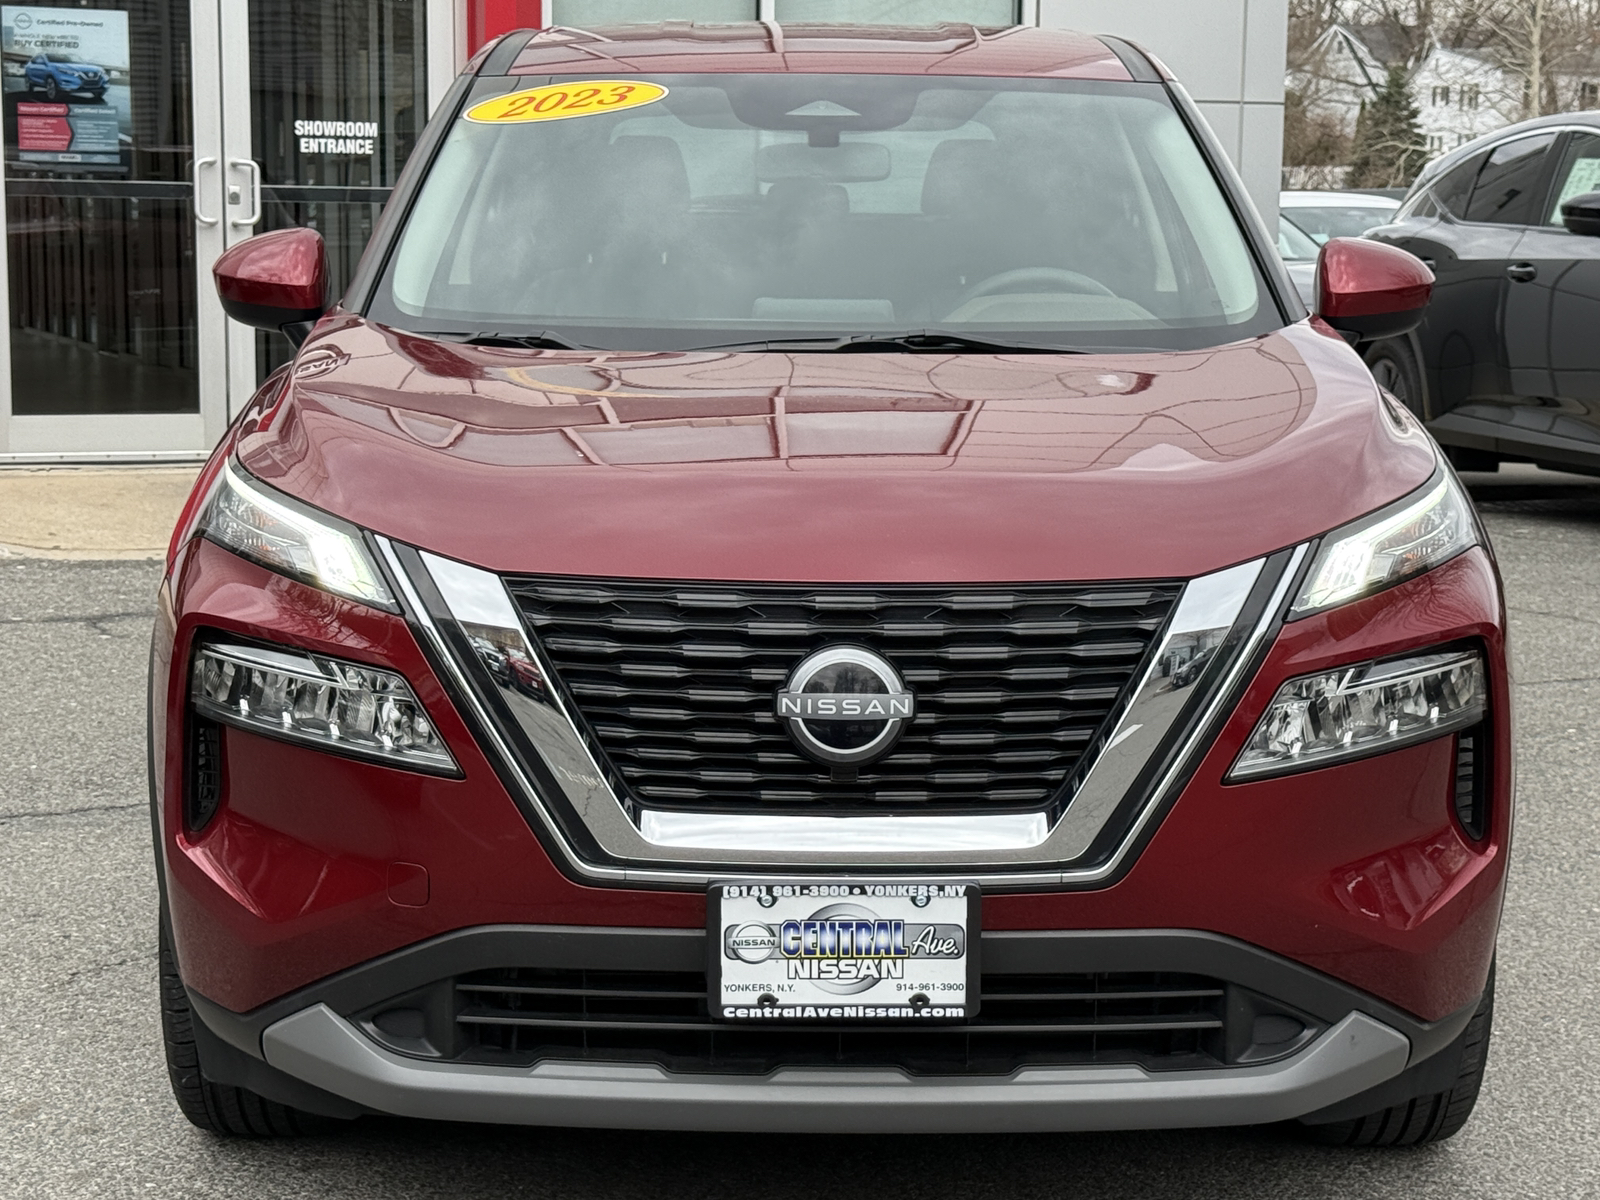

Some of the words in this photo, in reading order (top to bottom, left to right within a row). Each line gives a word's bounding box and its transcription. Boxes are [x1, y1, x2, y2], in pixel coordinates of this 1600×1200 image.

[34, 40, 80, 48] CERTIFIED
[497, 85, 636, 119] 2023
[294, 119, 378, 137] SHOWROOM
[299, 138, 374, 154] ENTRANCE
[781, 697, 909, 715] NISSAN
[780, 920, 910, 958] CENTRAL
[911, 925, 960, 955] Ave.
[787, 958, 904, 979] NISSAN
[724, 984, 775, 993] YONKERS,
[777, 984, 796, 992] N.Y.
[896, 983, 965, 991] 914-961-3900
[723, 1006, 965, 1018] CentralAveNissan.com
